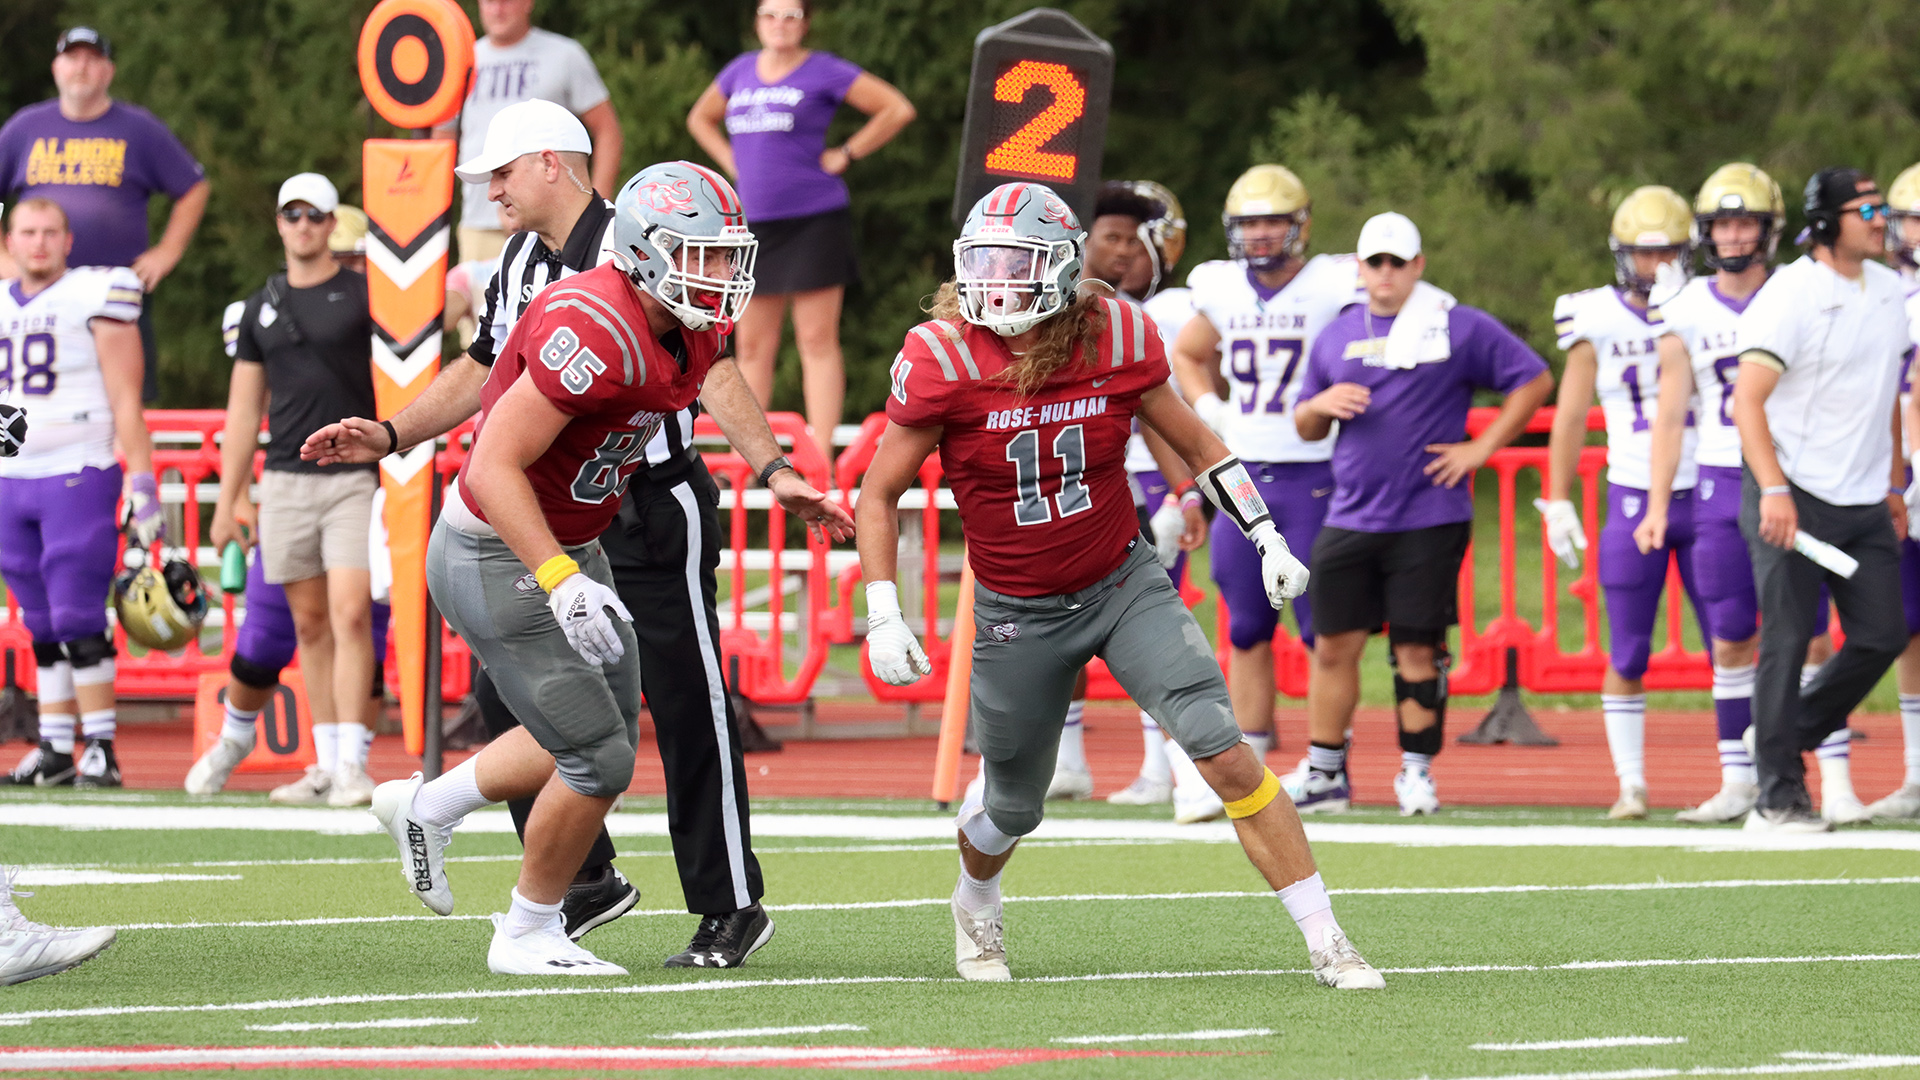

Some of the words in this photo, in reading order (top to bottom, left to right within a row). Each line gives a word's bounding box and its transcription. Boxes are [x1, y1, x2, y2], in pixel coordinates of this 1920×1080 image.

[986, 60, 1084, 178] 2
[26, 162, 124, 187] COLLEGE
[28, 137, 127, 164] ALBION
[520, 283, 534, 303] S
[1229, 314, 1306, 330] ALBION
[539, 326, 608, 395] 85
[1231, 338, 1304, 415] 97
[986, 396, 1108, 429] ROSE-HULMAN
[1006, 423, 1092, 526] 11
[566, 591, 585, 621] adidas
[217, 684, 299, 755] 0
[406, 819, 432, 892] ADIZERO
